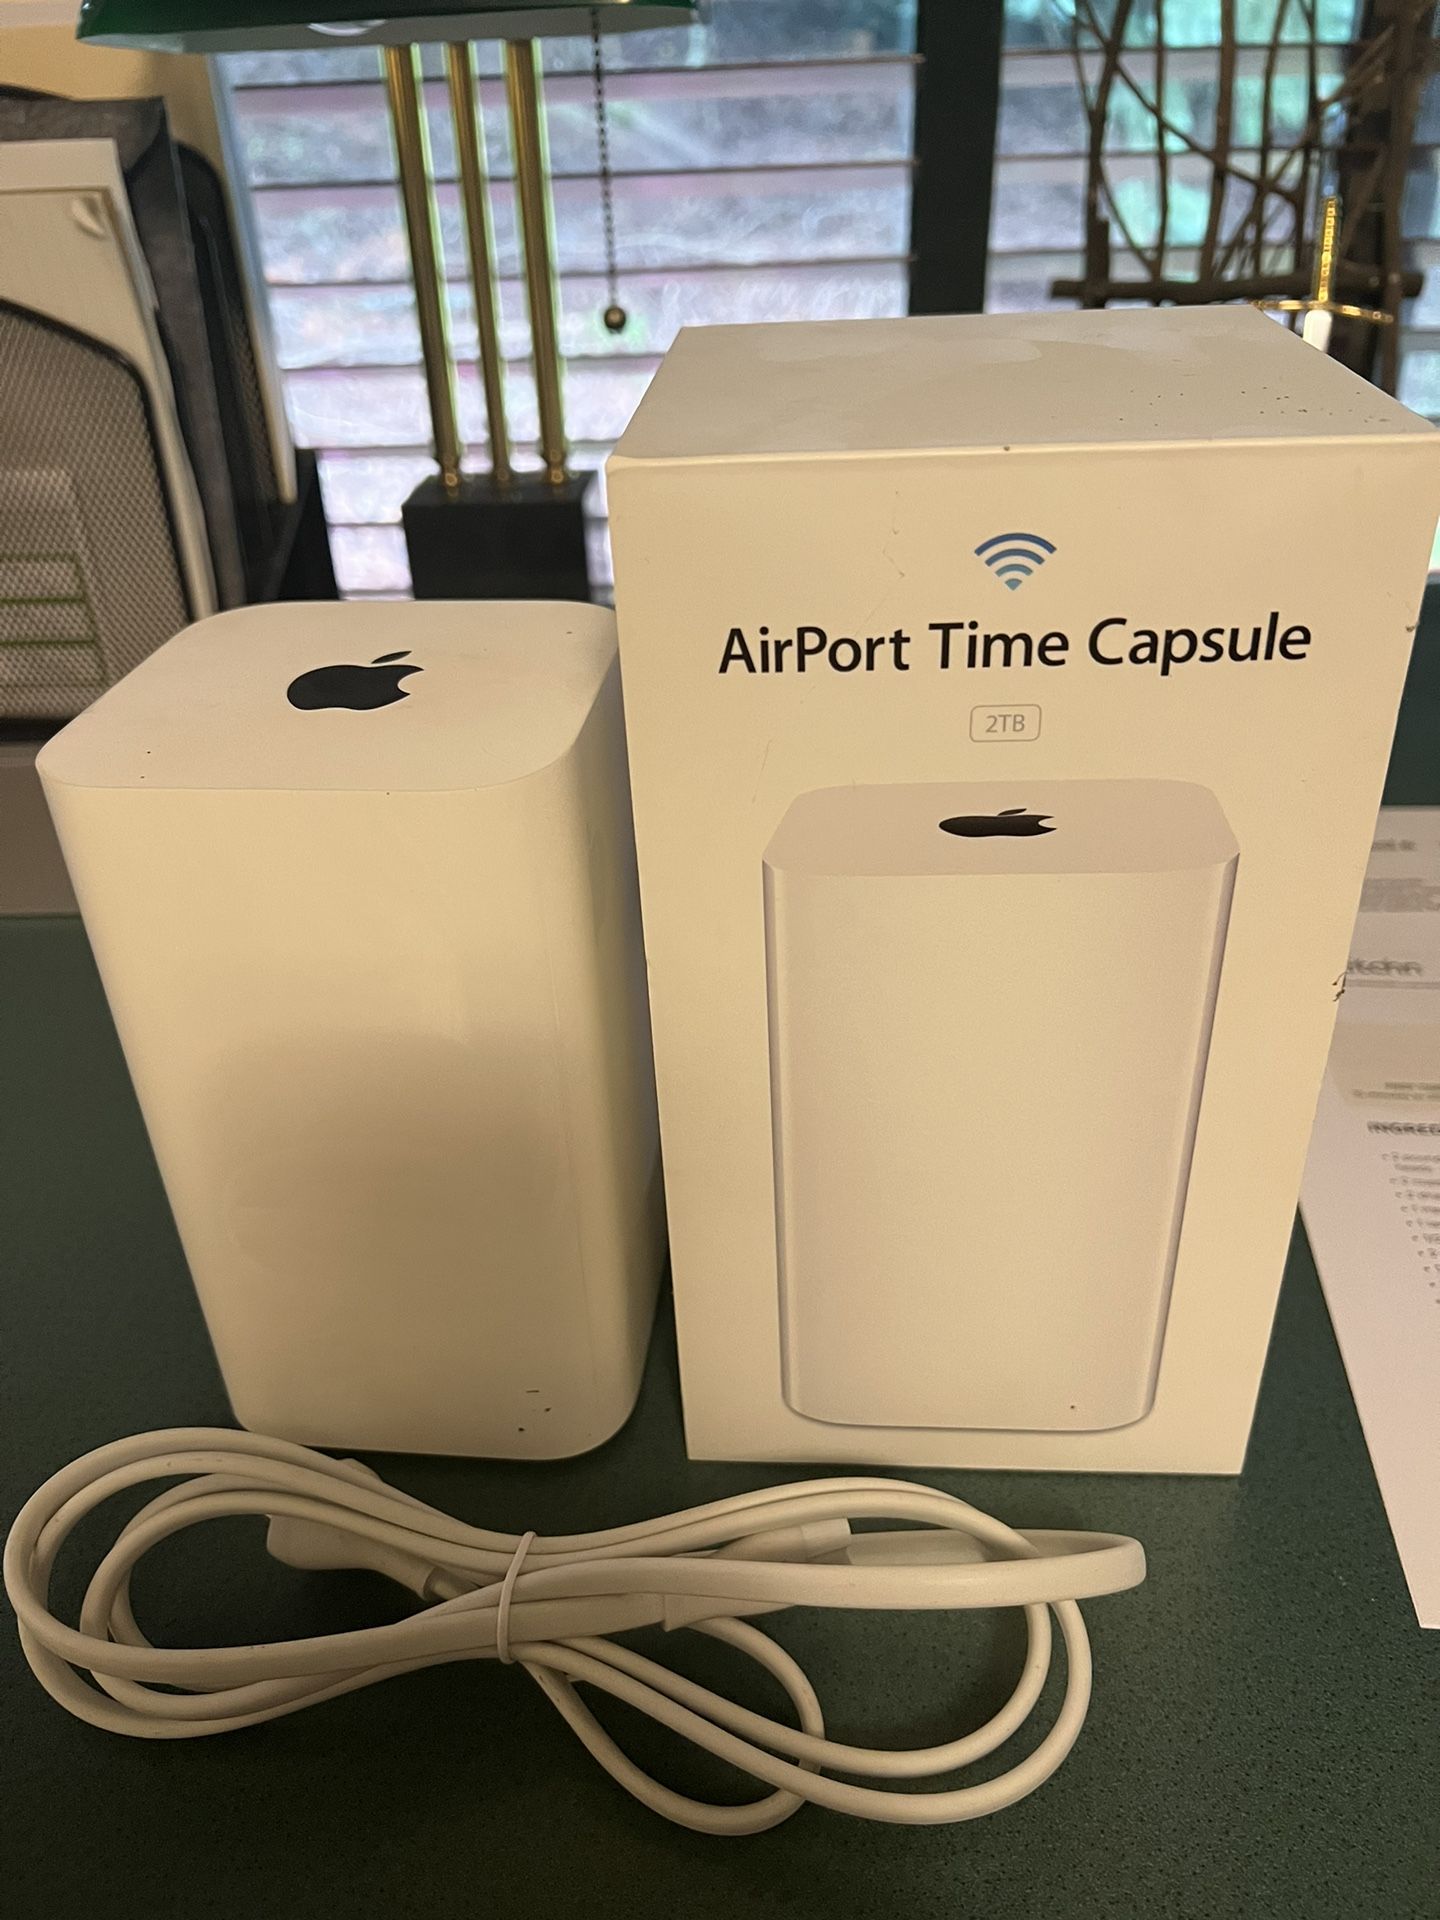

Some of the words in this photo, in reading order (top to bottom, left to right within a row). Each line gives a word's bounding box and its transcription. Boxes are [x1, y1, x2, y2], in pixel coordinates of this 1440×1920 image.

[719, 627, 910, 674] AirPort
[929, 621, 1069, 670] Time
[1089, 612, 1312, 677] Capsule
[985, 714, 1026, 733] 2TB
